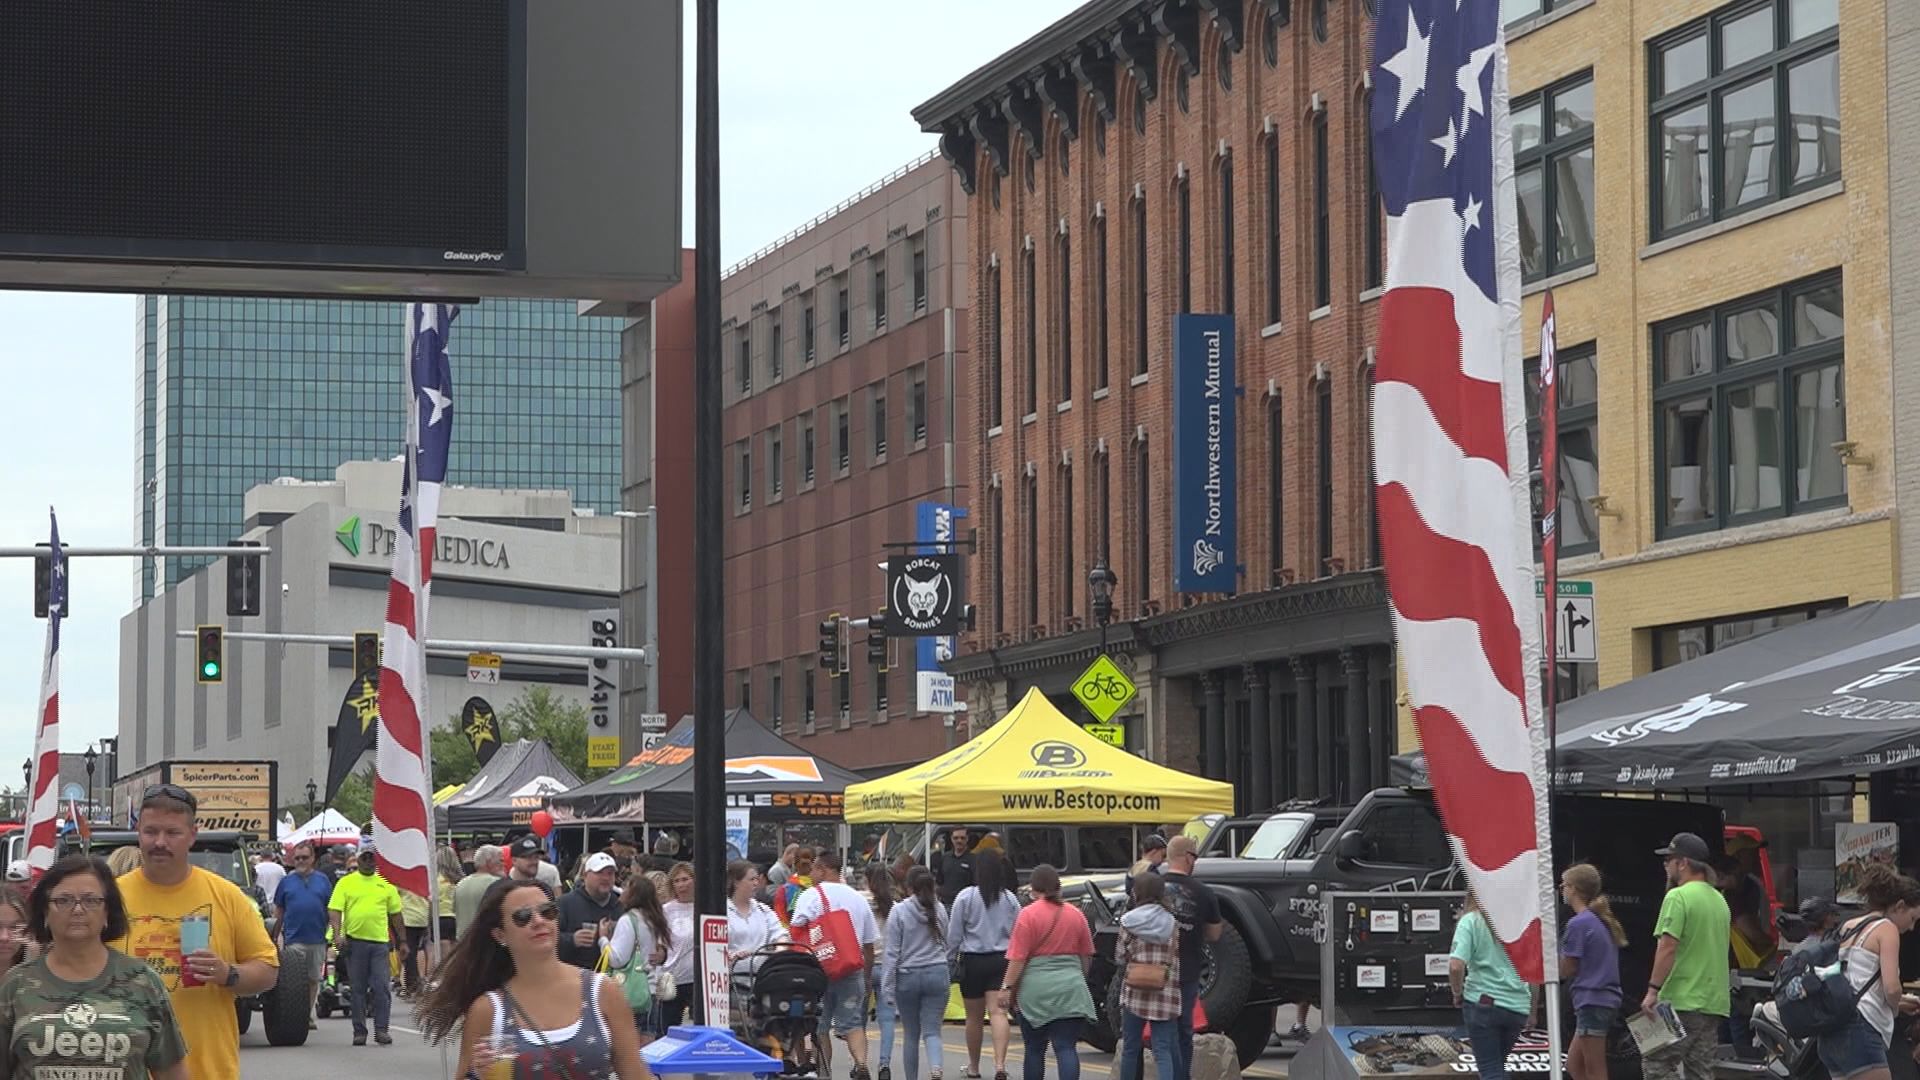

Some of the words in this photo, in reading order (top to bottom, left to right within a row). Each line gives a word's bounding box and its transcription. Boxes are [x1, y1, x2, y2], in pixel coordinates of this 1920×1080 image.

[1203, 330, 1221, 398] Mutual
[1204, 403, 1221, 536] Northwestern
[368, 522, 511, 570] PREDICA
[905, 558, 941, 572] BOBCAT
[904, 616, 942, 630] BONNIE'S
[590, 675, 616, 728] city
[930, 690, 953, 707] ATM
[183, 773, 259, 782] SpicerParts.com
[726, 793, 844, 807] ILESTAR
[1002, 789, 1161, 815] www.Bestop.com
[195, 812, 262, 832] enuine
[28, 1025, 131, 1063] Jeep
